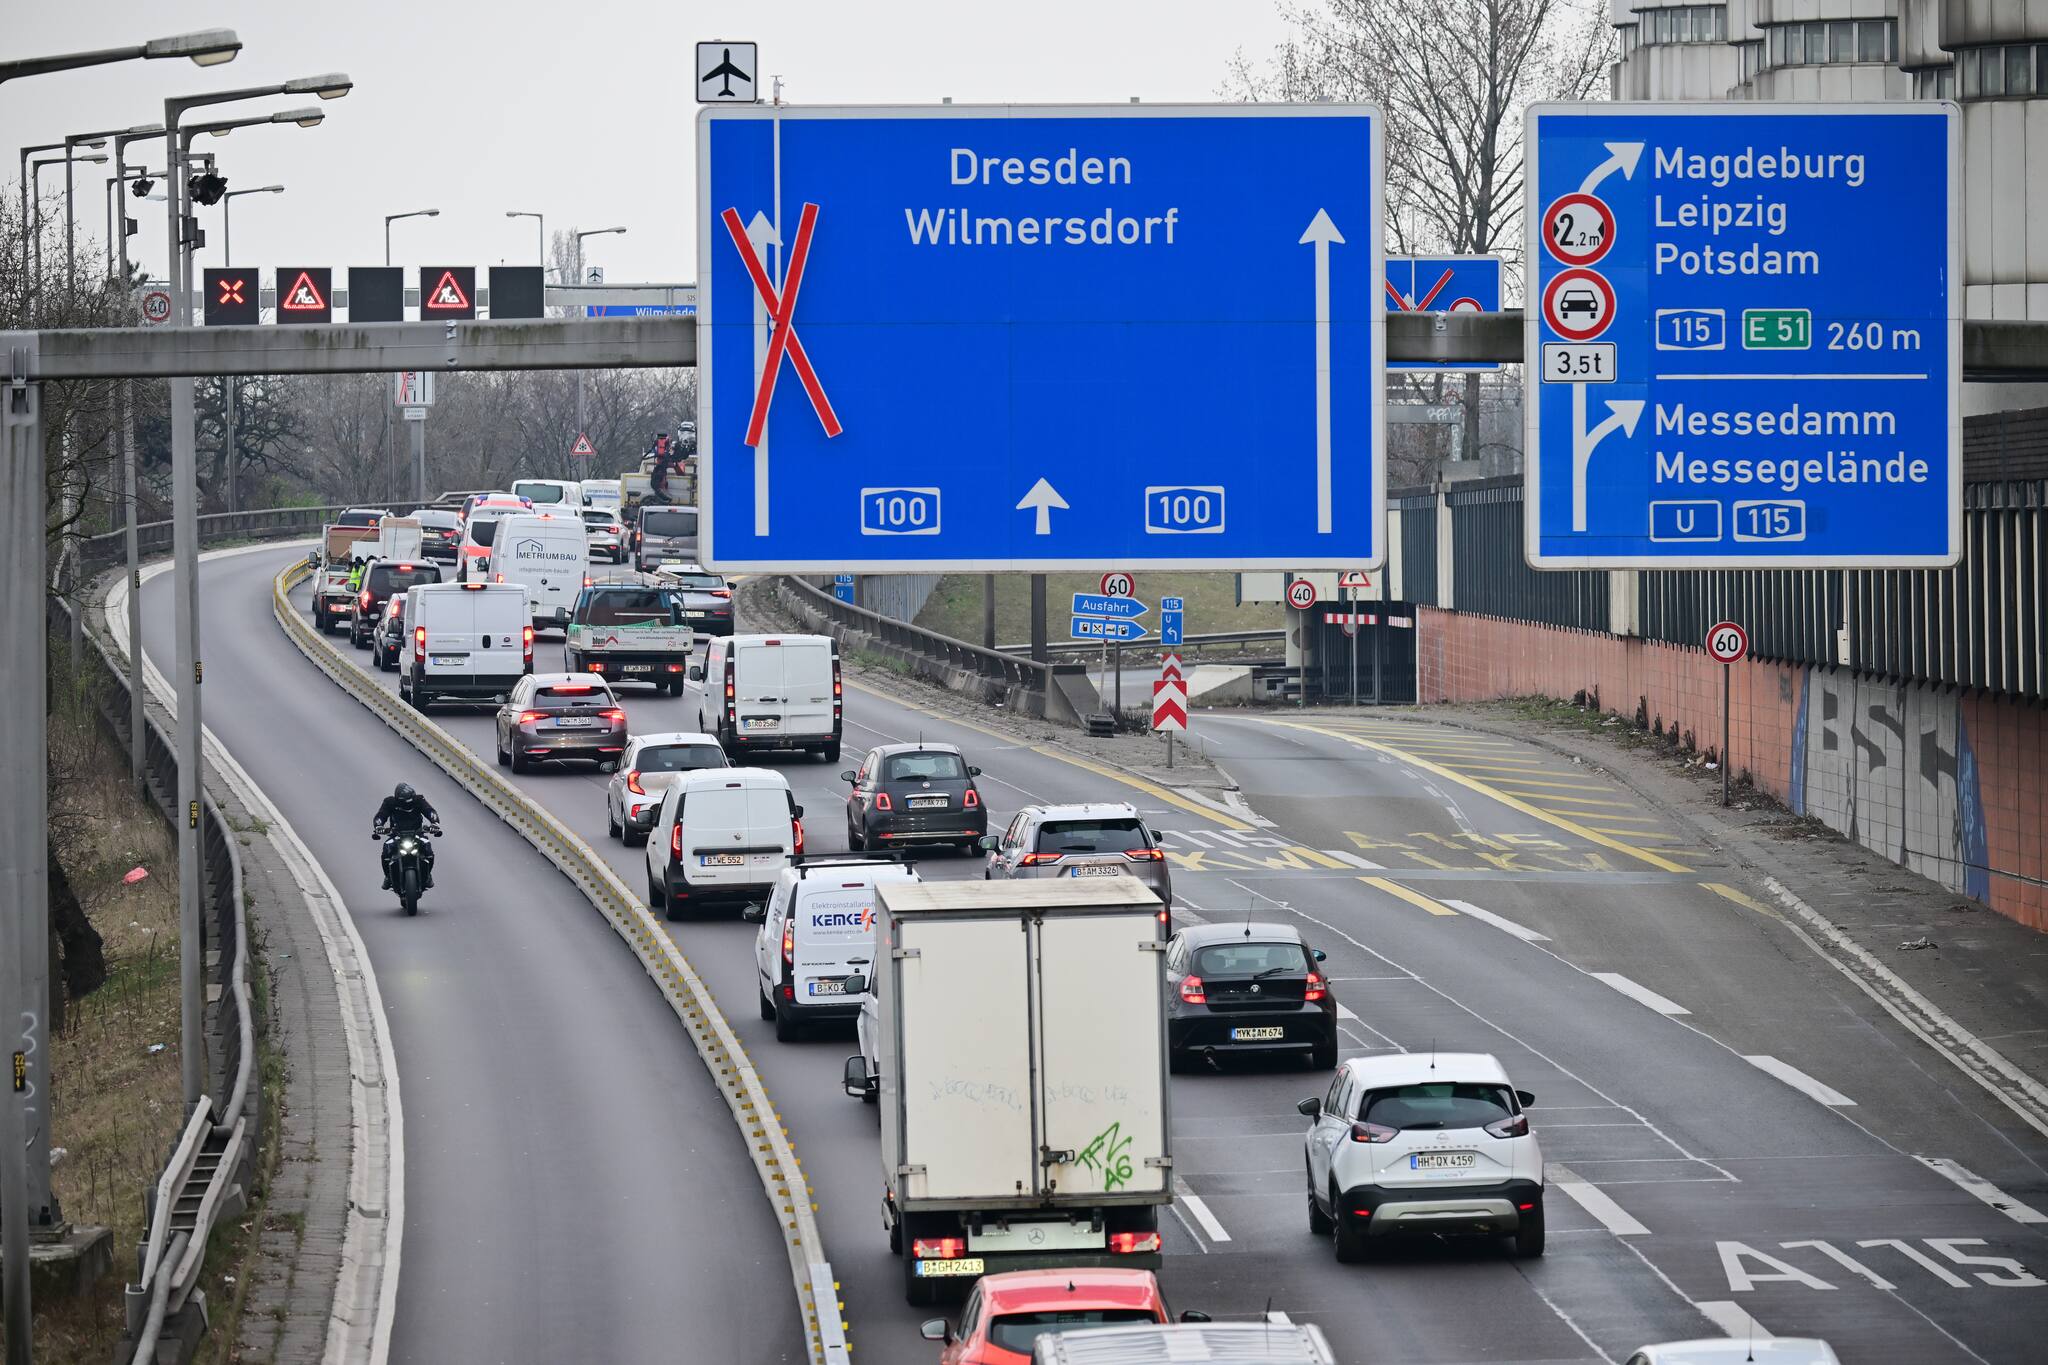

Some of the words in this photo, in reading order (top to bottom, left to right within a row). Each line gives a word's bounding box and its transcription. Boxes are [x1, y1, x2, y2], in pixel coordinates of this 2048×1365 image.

[951, 148, 1132, 185] Dresden
[1655, 146, 1865, 188] Magdeburg
[904, 207, 1179, 245] Wilmersdorf
[1655, 194, 1787, 235] Leipzig
[1655, 242, 1819, 275] Potsdam
[1672, 317, 1710, 342] 115
[1749, 317, 1767, 341] E
[1777, 317, 1805, 341] 51
[1827, 322, 1884, 350] 260
[1892, 329, 1921, 350] m
[1655, 403, 1897, 436] Messedamm
[1655, 451, 1929, 492] Messegelände
[874, 496, 927, 525] 100
[1158, 495, 1211, 524] 100
[1676, 509, 1695, 533] U
[1748, 508, 1791, 534] 115
[1108, 579, 1128, 595] 60
[1294, 588, 1311, 601] 40
[1082, 599, 1130, 613] Ausfahrt
[1166, 600, 1179, 608] 115
[1165, 615, 1172, 623] U
[1716, 633, 1738, 652] 60
[1160, 829, 1292, 849] 115
[1165, 850, 1314, 872] KW
[812, 913, 864, 927] KEMKE
[1714, 1238, 2048, 1292] A115
